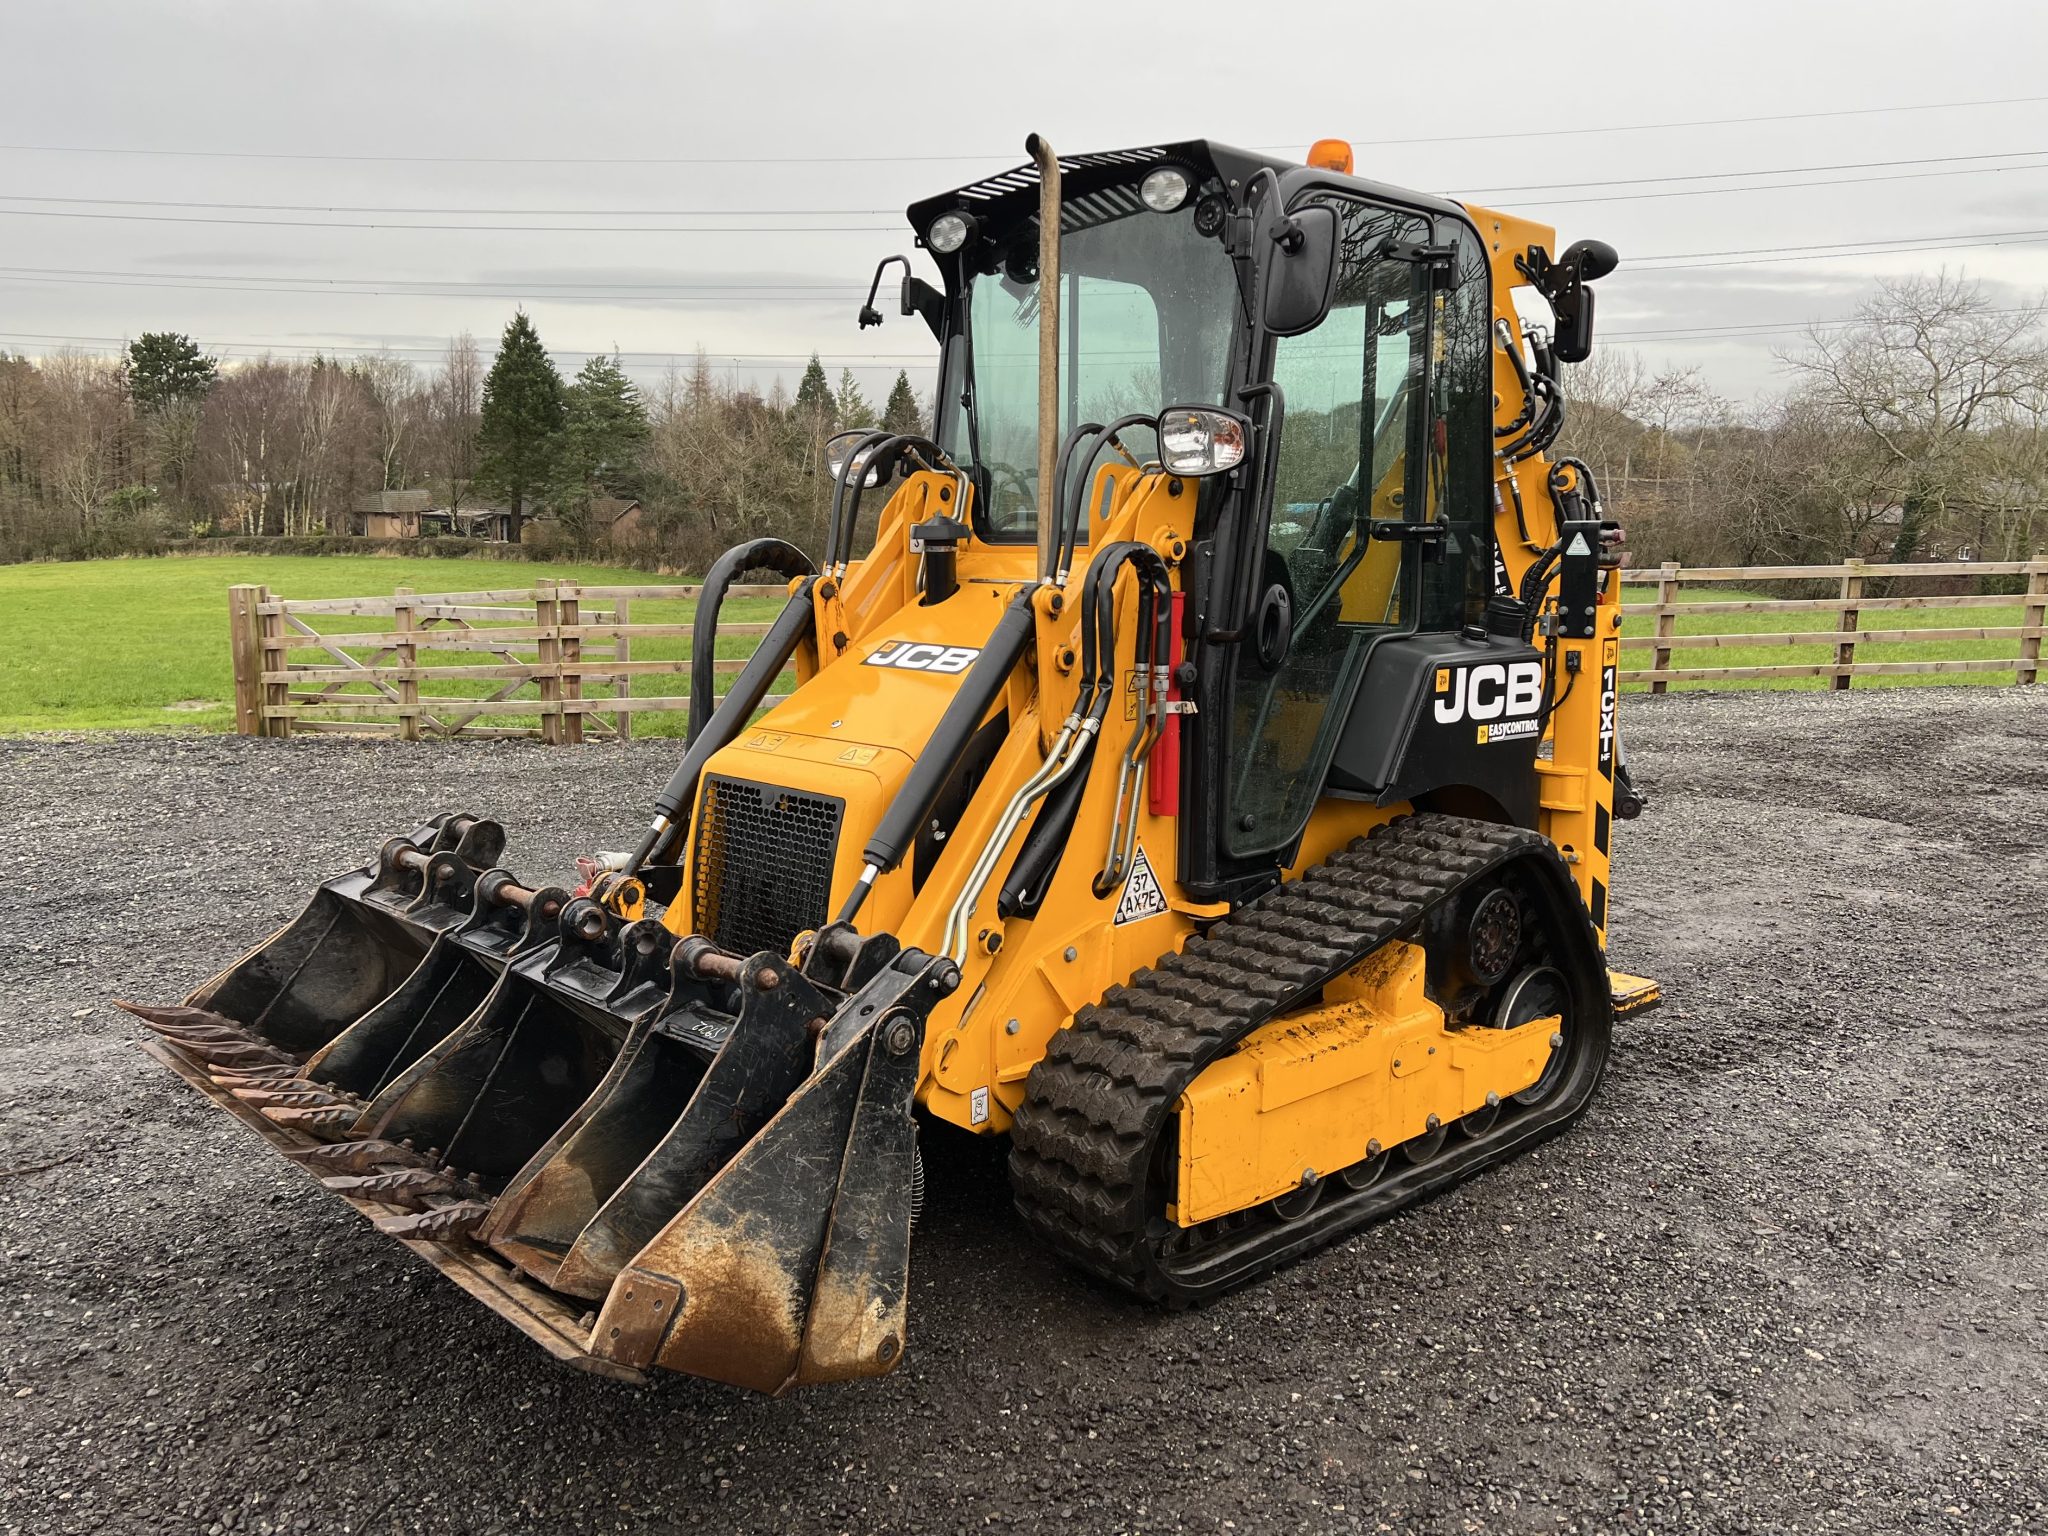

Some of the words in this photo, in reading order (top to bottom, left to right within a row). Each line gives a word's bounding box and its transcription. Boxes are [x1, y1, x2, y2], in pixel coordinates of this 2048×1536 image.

[866, 644, 981, 672] JCB
[1434, 662, 1542, 724] JCB
[1600, 668, 1614, 752] 1CXT
[1488, 719, 1539, 740] EASYCONTROL
[1600, 753, 1611, 762] HF
[1133, 874, 1148, 893] 37
[1126, 890, 1157, 914] AX7E
